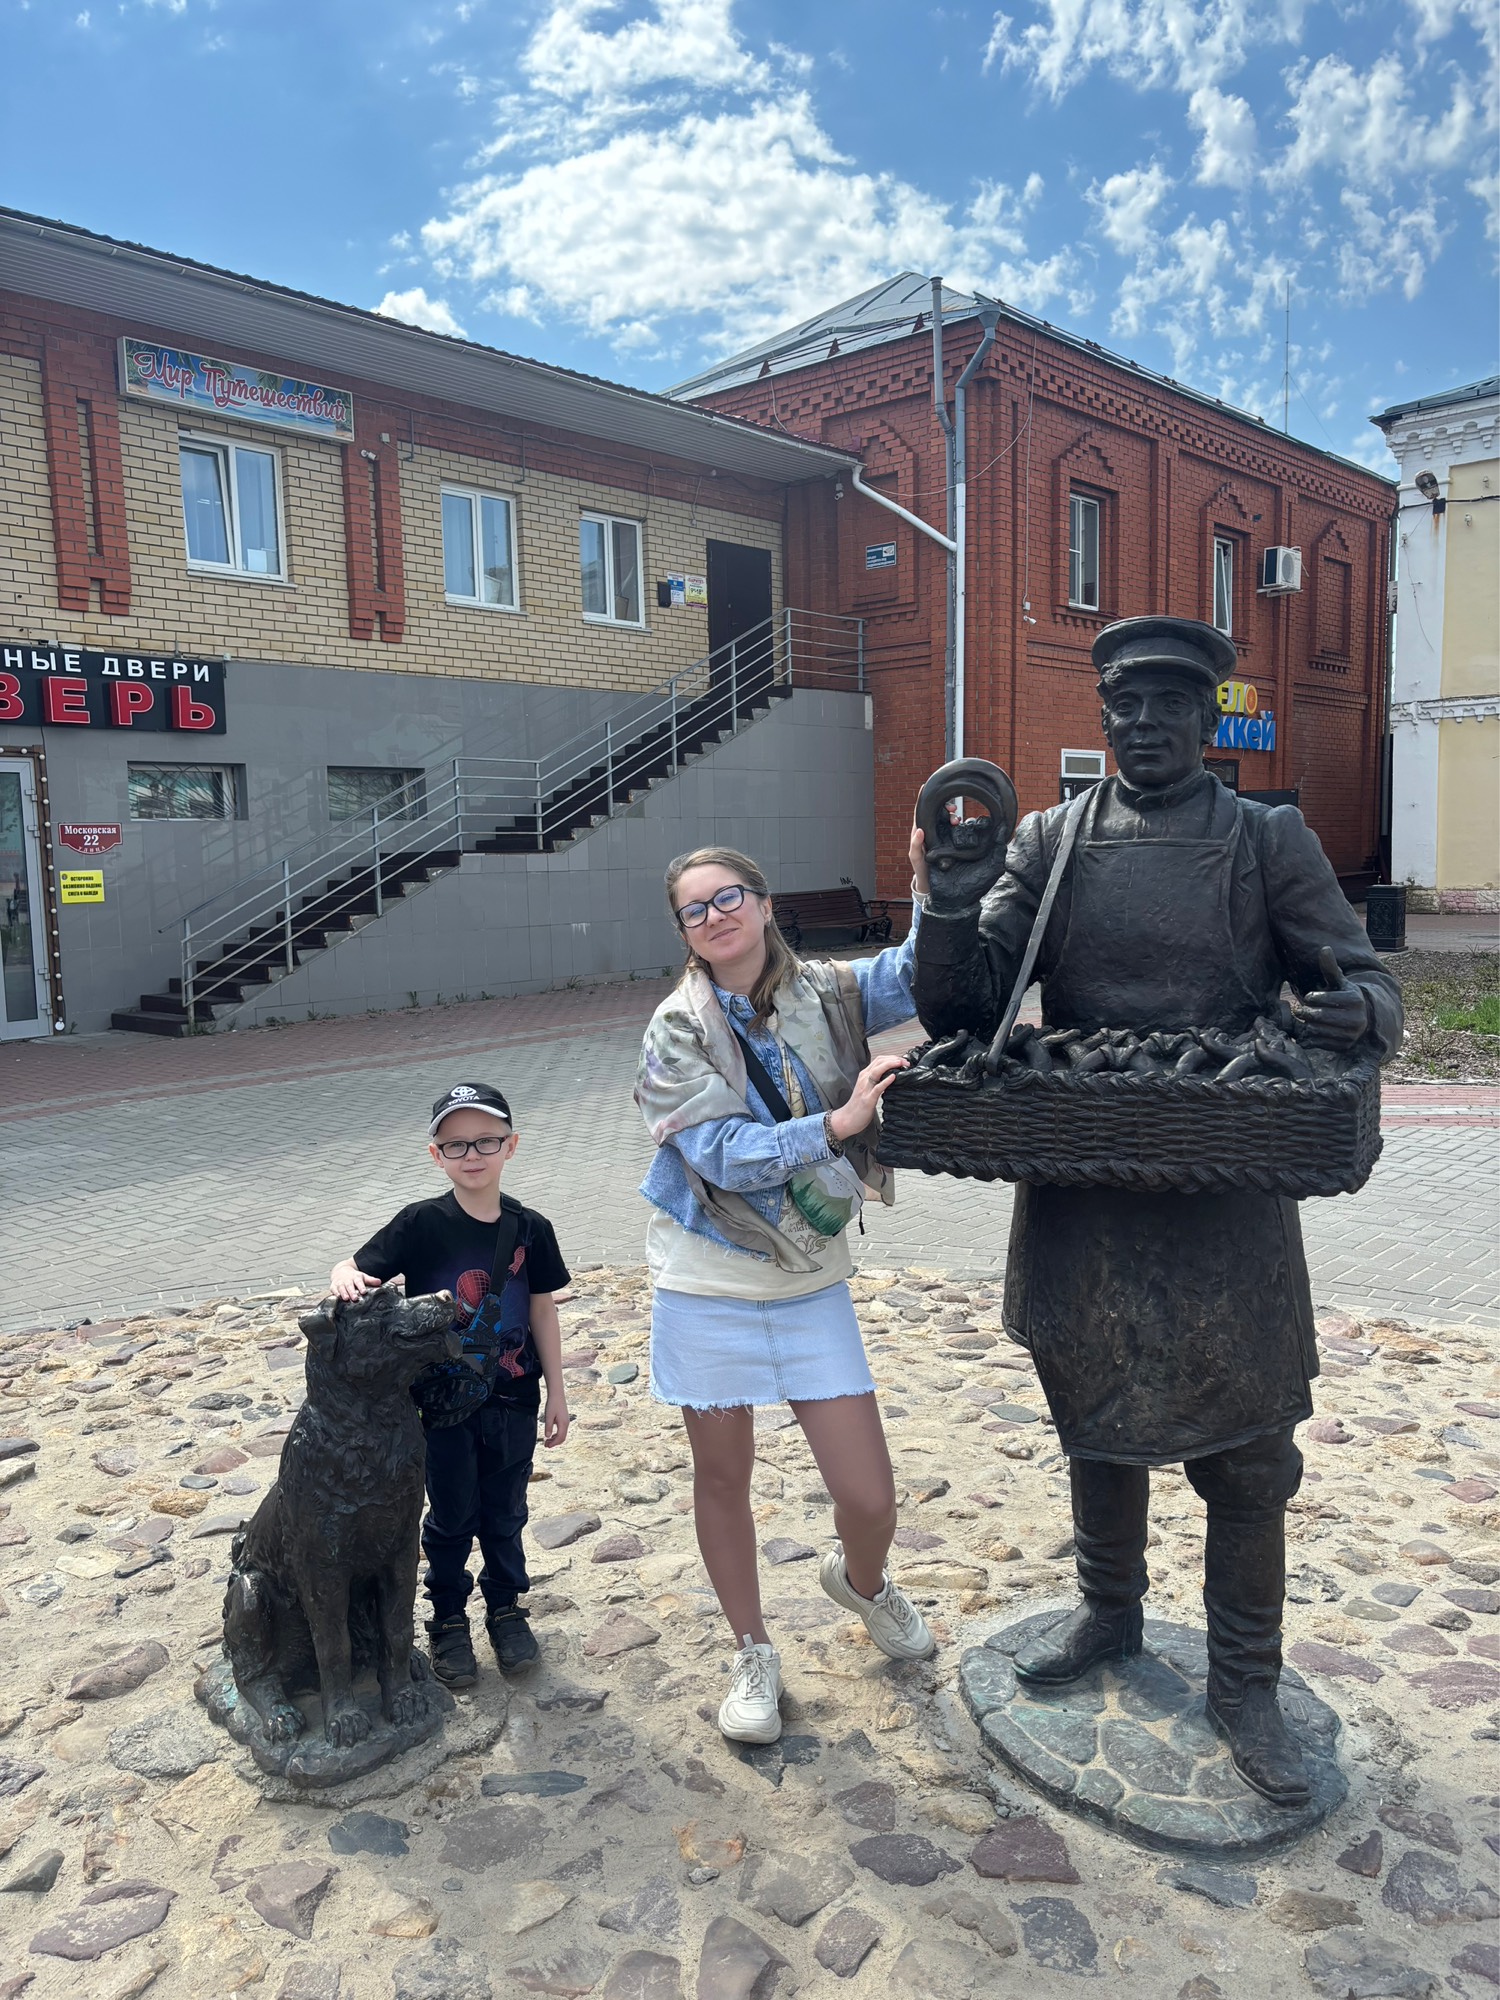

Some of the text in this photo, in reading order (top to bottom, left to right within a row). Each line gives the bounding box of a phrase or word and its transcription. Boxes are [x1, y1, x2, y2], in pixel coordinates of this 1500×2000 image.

[133, 351, 346, 422] Мир Путешествий
[3, 648, 210, 683] НЫЕ ДВЕРИ
[64, 825, 117, 834] Московская
[83, 834, 99, 846] 22
[447, 1095, 480, 1105] TOYOTA
